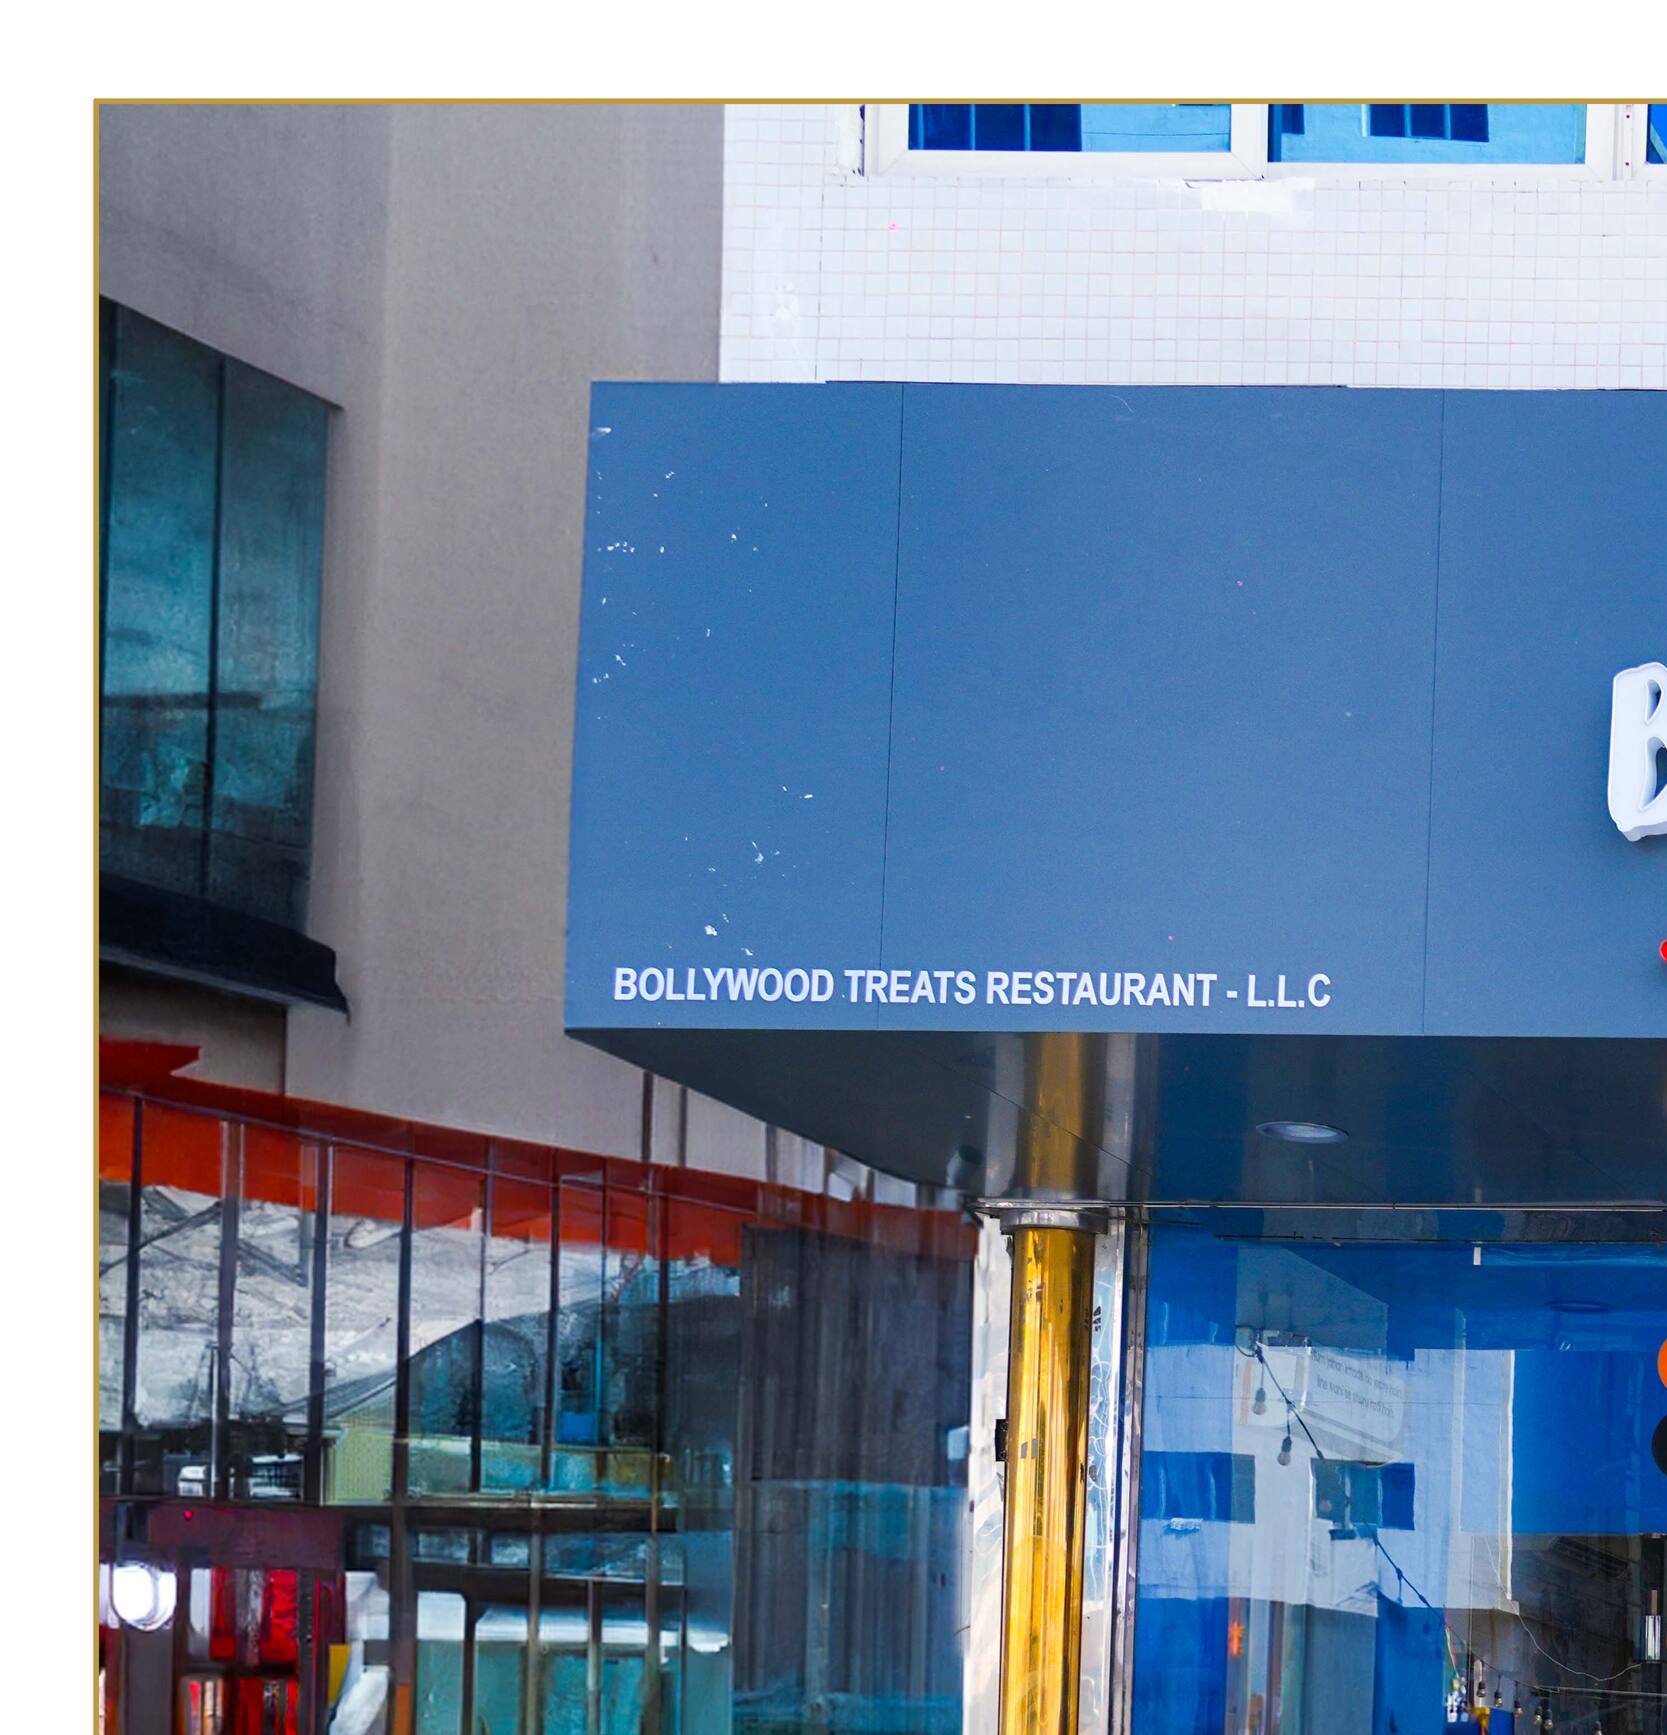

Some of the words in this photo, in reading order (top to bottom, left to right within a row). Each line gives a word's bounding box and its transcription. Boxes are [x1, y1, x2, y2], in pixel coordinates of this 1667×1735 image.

[614, 967, 834, 1002] BOLLYWOOD
[842, 969, 976, 1005] TREATS
[986, 970, 1218, 1007] RESTAURANT
[1247, 973, 1331, 1008] L.L.C
